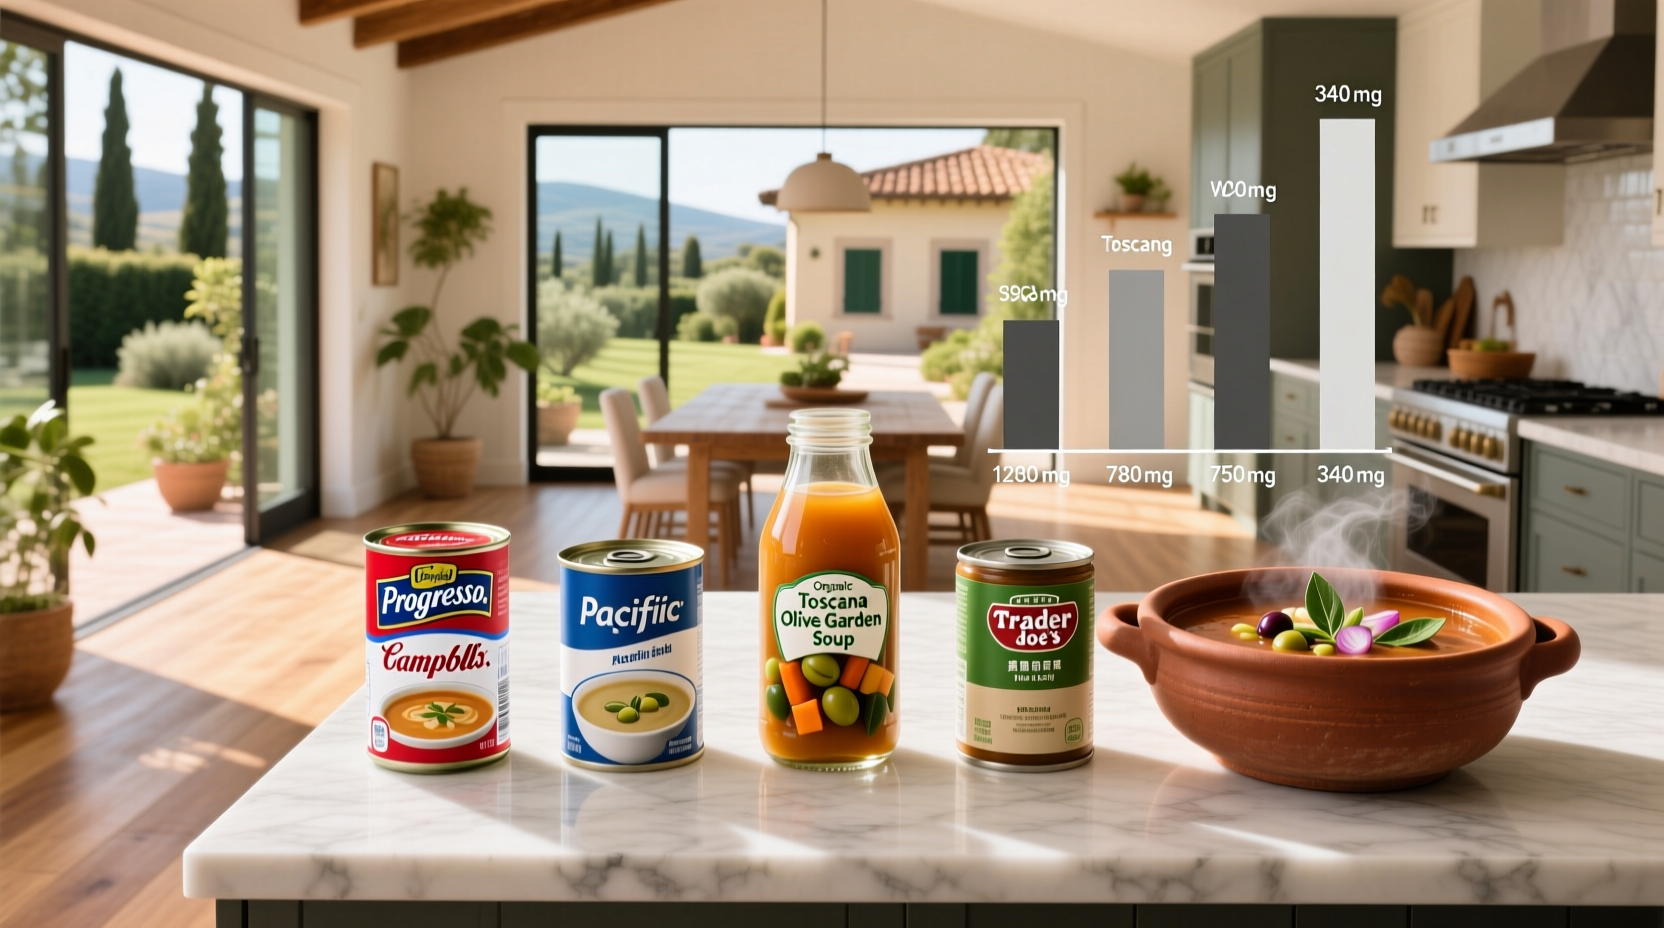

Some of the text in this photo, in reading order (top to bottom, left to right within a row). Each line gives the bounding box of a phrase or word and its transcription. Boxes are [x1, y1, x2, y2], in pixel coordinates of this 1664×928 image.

[798, 592, 868, 609] Toscana
[781, 610, 882, 628] Olive Garden
[993, 608, 1072, 629] Trader
[813, 630, 855, 650] Soup
